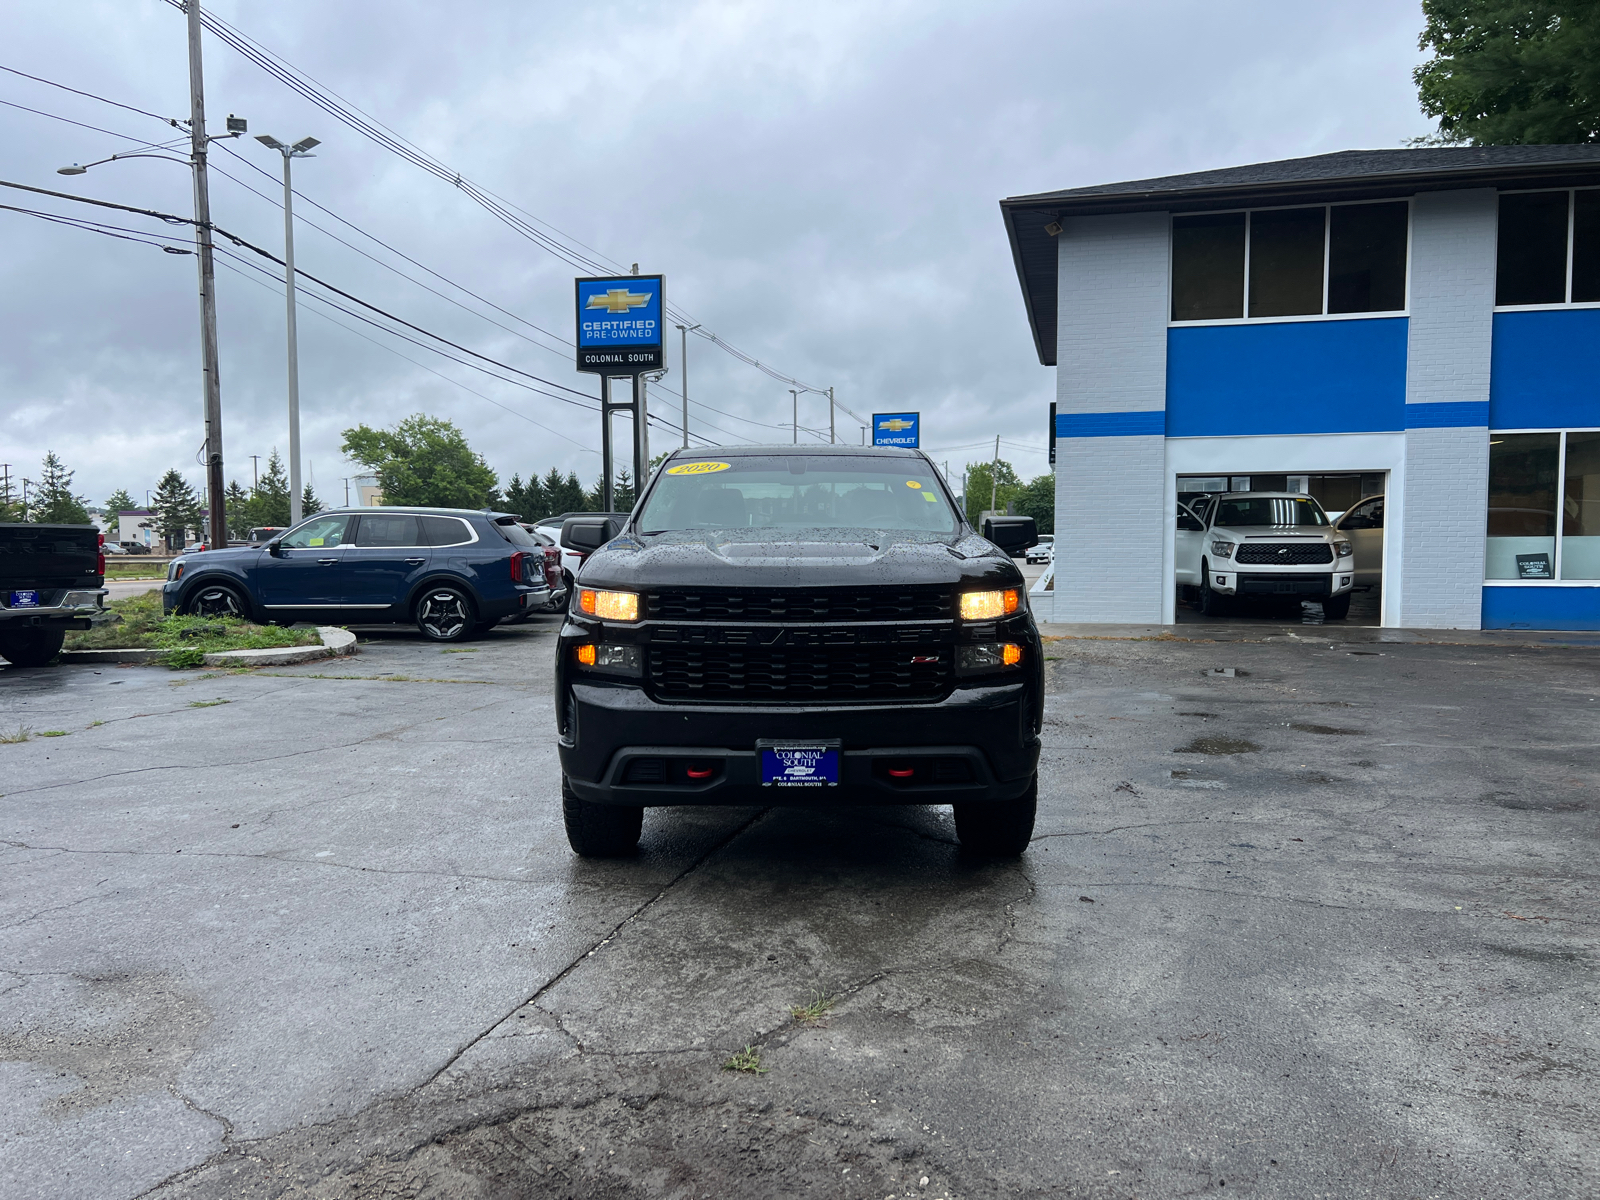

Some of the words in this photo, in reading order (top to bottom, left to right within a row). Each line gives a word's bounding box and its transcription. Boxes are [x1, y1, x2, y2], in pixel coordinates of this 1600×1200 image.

[582, 320, 656, 330] CERTIFIED
[586, 330, 652, 339] PRE-OWNED
[586, 354, 624, 363] COLONIAL
[628, 354, 654, 362] SOUTH
[675, 464, 720, 474] 2020
[650, 628, 952, 645] CHEVROLET
[776, 751, 824, 759] COLONIAL
[783, 758, 816, 766] SOUTH
